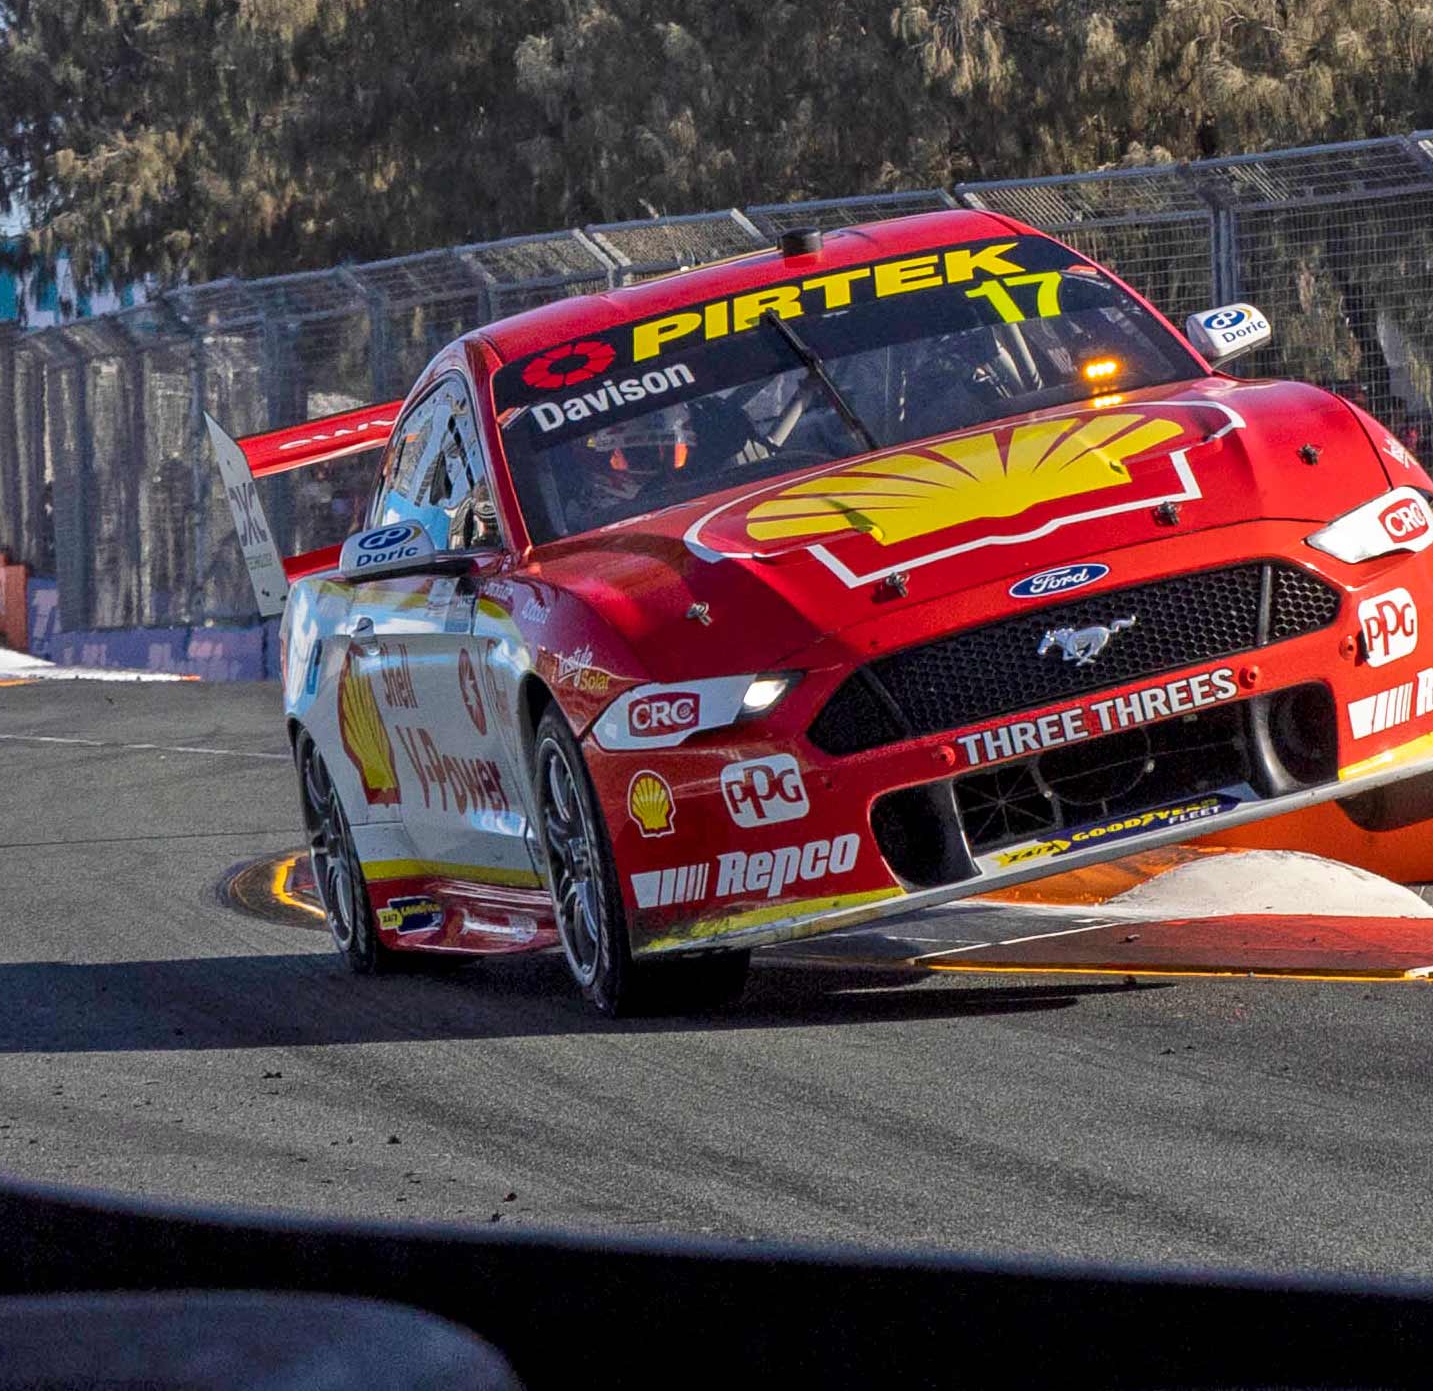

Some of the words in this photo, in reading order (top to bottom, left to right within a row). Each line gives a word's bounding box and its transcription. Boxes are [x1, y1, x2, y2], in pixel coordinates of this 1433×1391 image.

[632, 241, 1025, 362] PIRTEK
[965, 271, 1062, 324] 17
[1222, 319, 1267, 343] Doric
[530, 360, 696, 434] Davison
[1384, 501, 1427, 538] CRC
[356, 546, 419, 568] Doric
[1030, 567, 1090, 594] Ford
[1363, 600, 1415, 656] PPG
[580, 669, 610, 690] Solar
[630, 697, 696, 731] CRC
[958, 710, 1088, 766] THREE
[1097, 668, 1239, 732] THREES
[724, 763, 804, 819] PPG
[1071, 798, 1219, 842] GOODYEAR
[1169, 805, 1221, 825] FLEET
[715, 833, 861, 898] Repco
